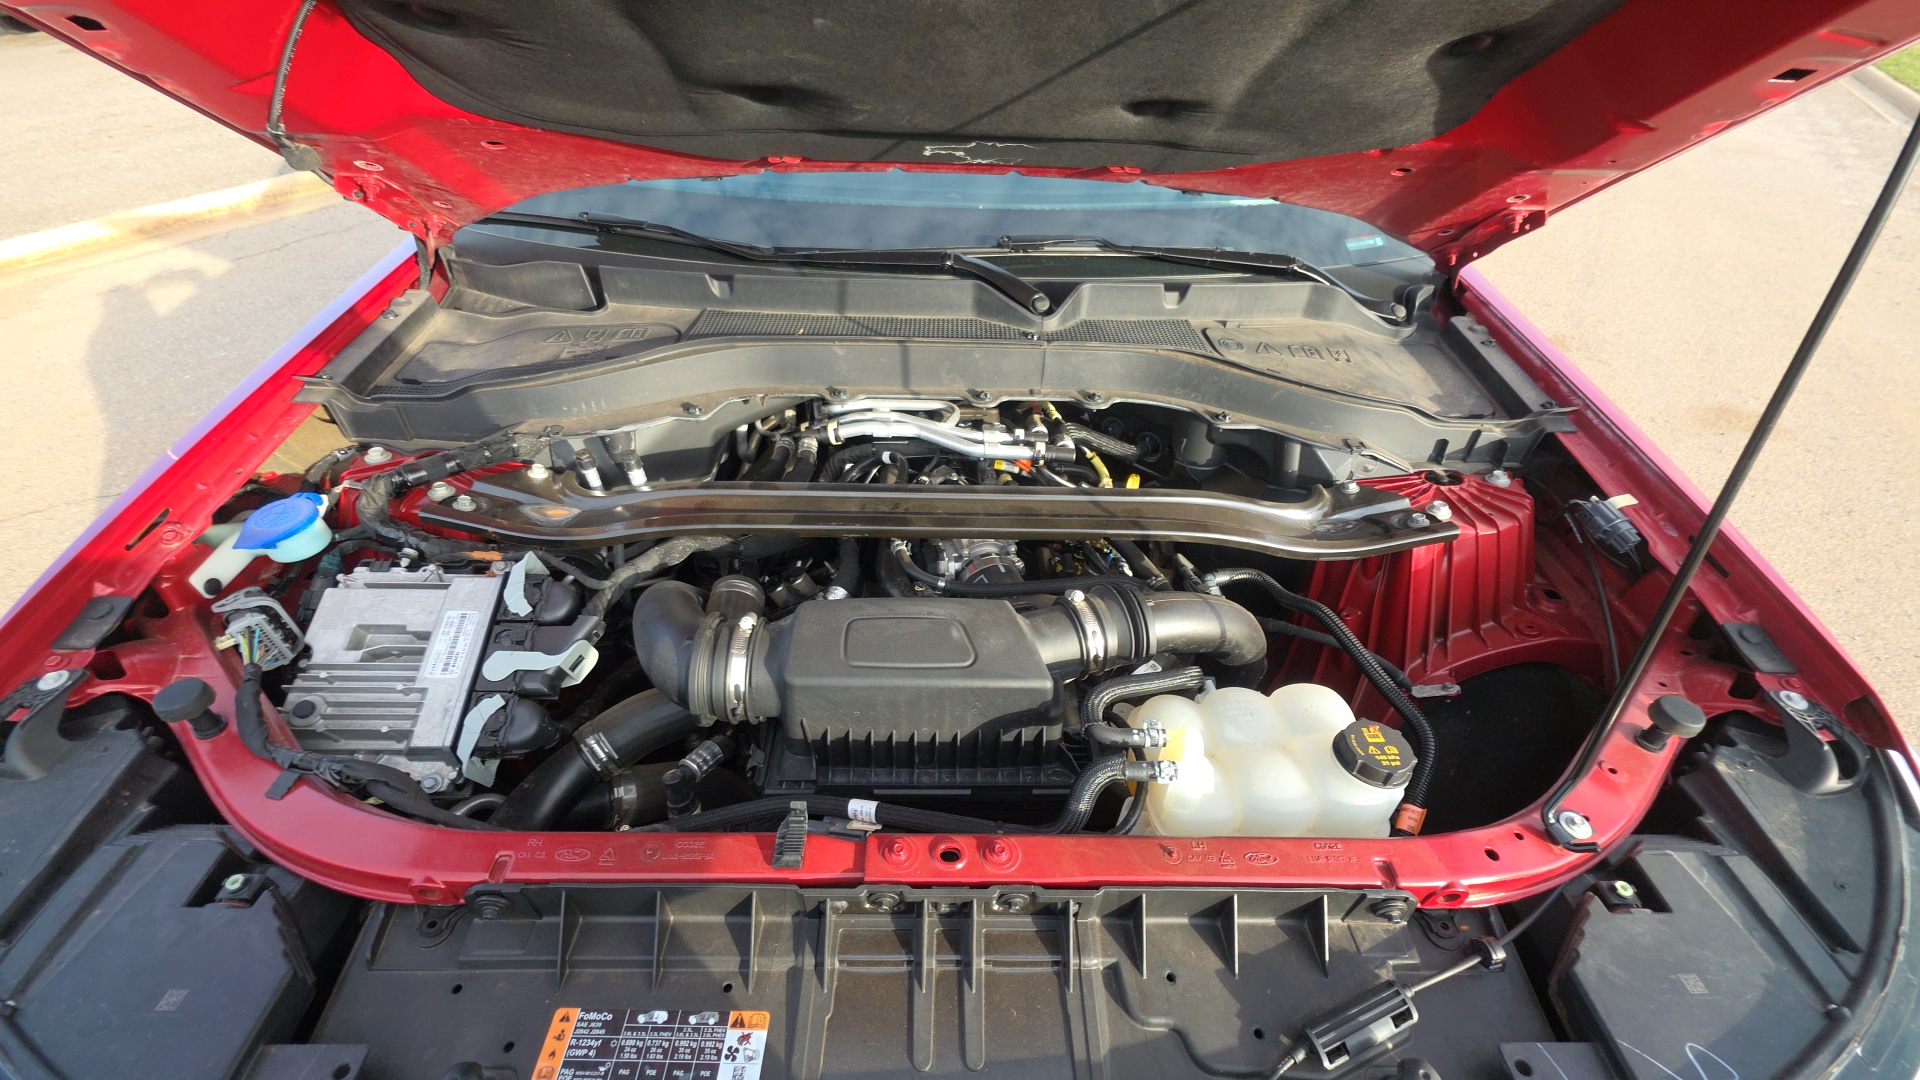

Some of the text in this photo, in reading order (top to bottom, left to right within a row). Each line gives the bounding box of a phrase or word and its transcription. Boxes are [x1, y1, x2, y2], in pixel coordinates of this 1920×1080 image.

[527, 838, 544, 847] RH
[579, 1012, 613, 1020] FoMoCo
[570, 1039, 602, 1048] R-1234yf
[662, 1040, 670, 1048] kg
[716, 1041, 723, 1049] kg
[566, 1049, 597, 1058] (GWP 4)
